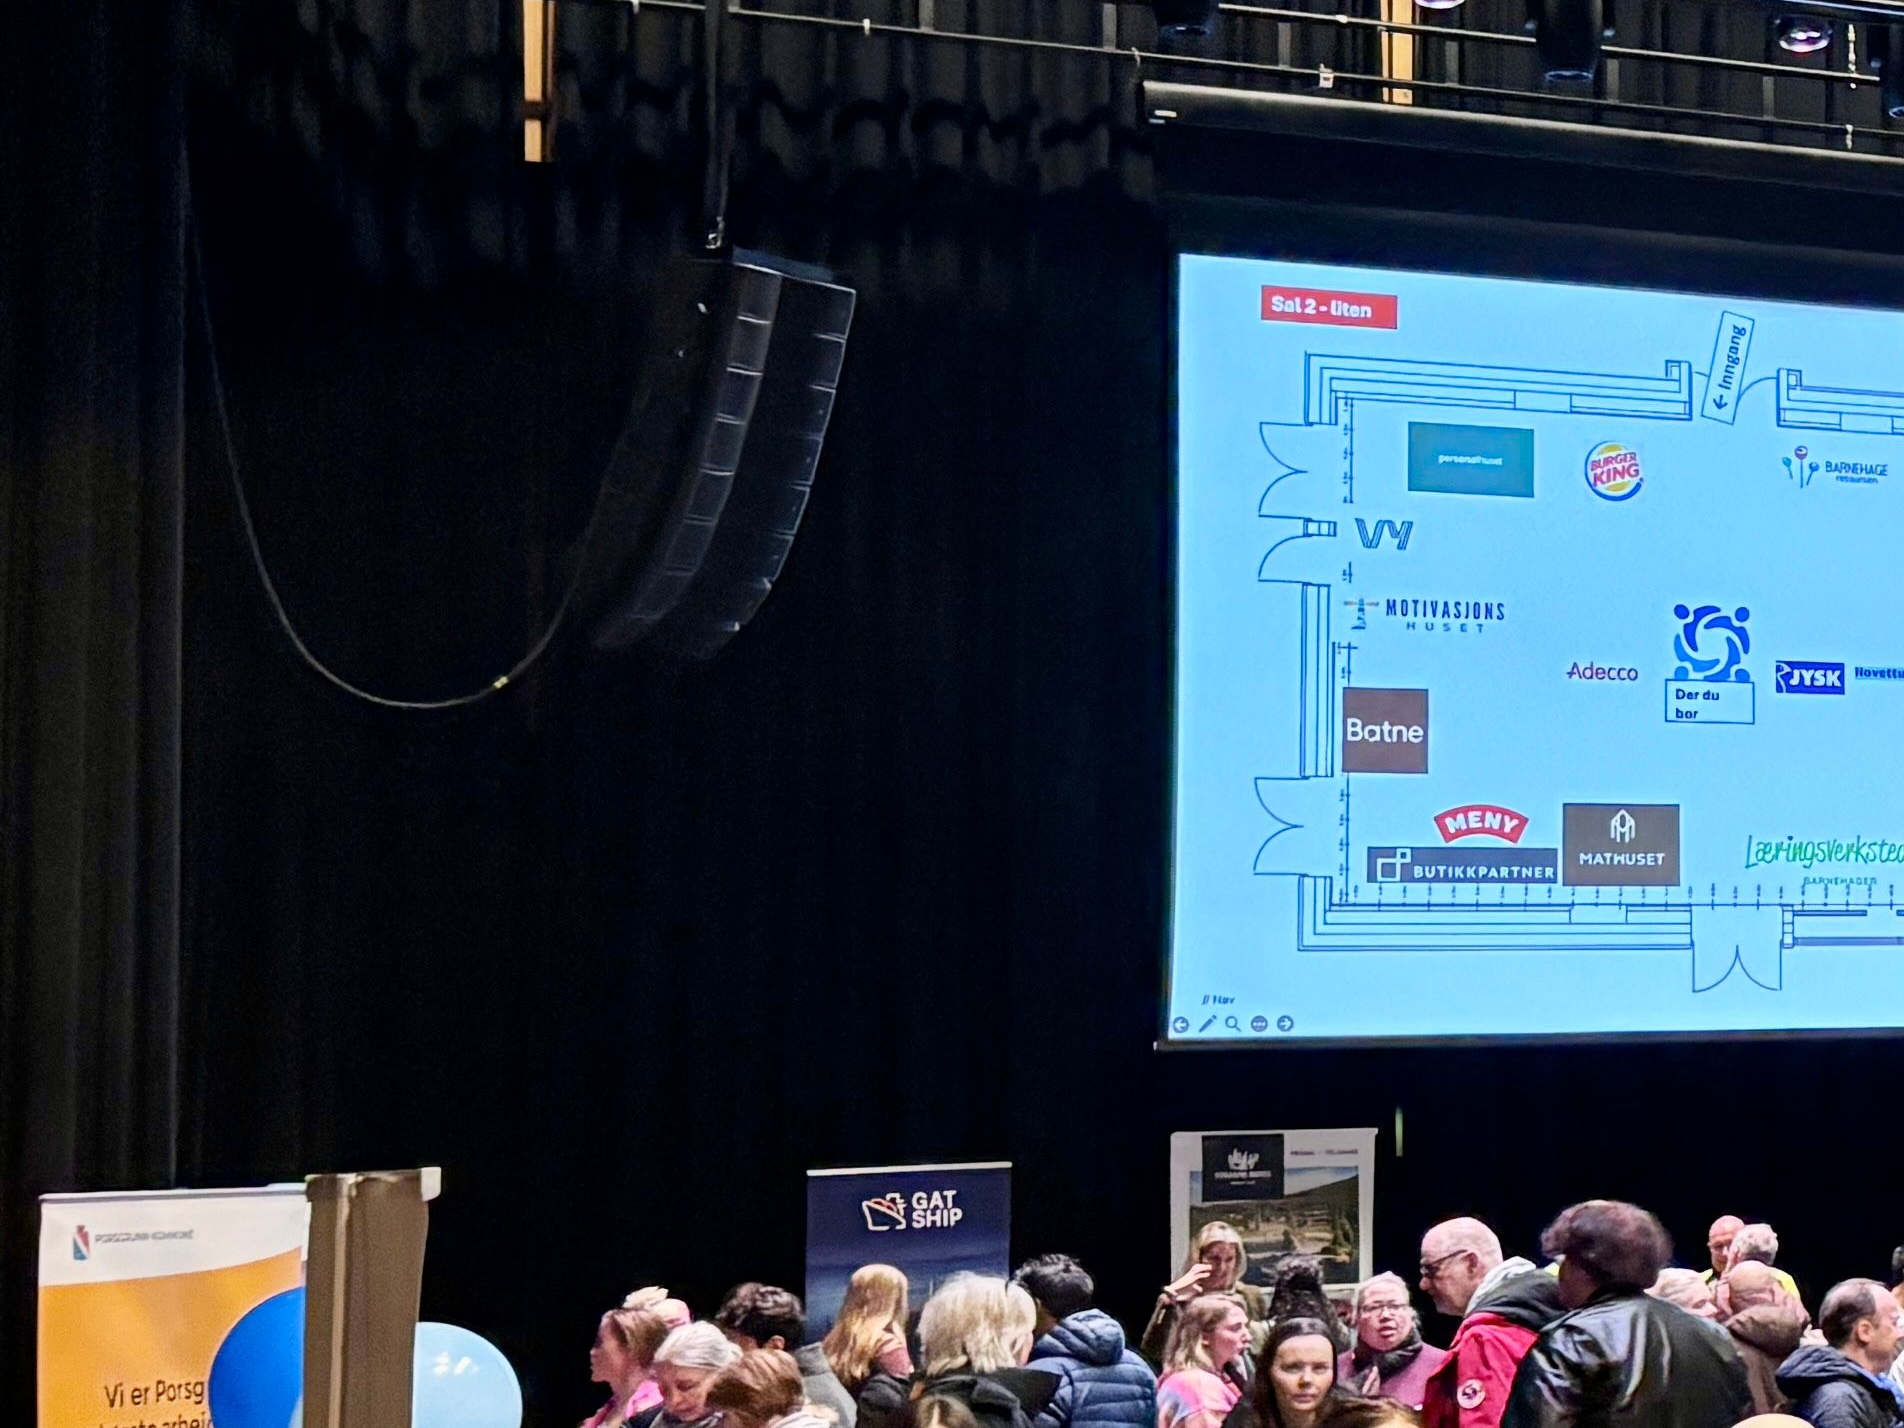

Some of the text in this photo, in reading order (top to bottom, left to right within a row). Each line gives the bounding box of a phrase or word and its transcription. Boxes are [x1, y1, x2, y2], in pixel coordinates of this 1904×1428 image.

[1271, 295, 1302, 313] Sal
[1304, 298, 1317, 315] 2
[1330, 300, 1372, 318] liten
[1717, 324, 1747, 390] Inngang
[1590, 451, 1637, 472] BURGER
[1592, 463, 1640, 487] KING
[1385, 598, 1506, 621] MOTIVASJONS
[1406, 622, 1484, 633] HUSET
[1566, 662, 1639, 681] Adecco
[1788, 668, 1841, 687] JYSK
[1675, 688, 1720, 701] Der du
[1675, 708, 1699, 719] bor
[1346, 717, 1424, 743] Batne
[1444, 810, 1519, 835] MENY
[1579, 852, 1666, 866] MATHUSET
[1413, 865, 1555, 880] BUTIKKPARTNER
[911, 1189, 957, 1210] GAT
[911, 1207, 963, 1228] SHIP
[104, 1379, 205, 1408] Vi er Porsg
